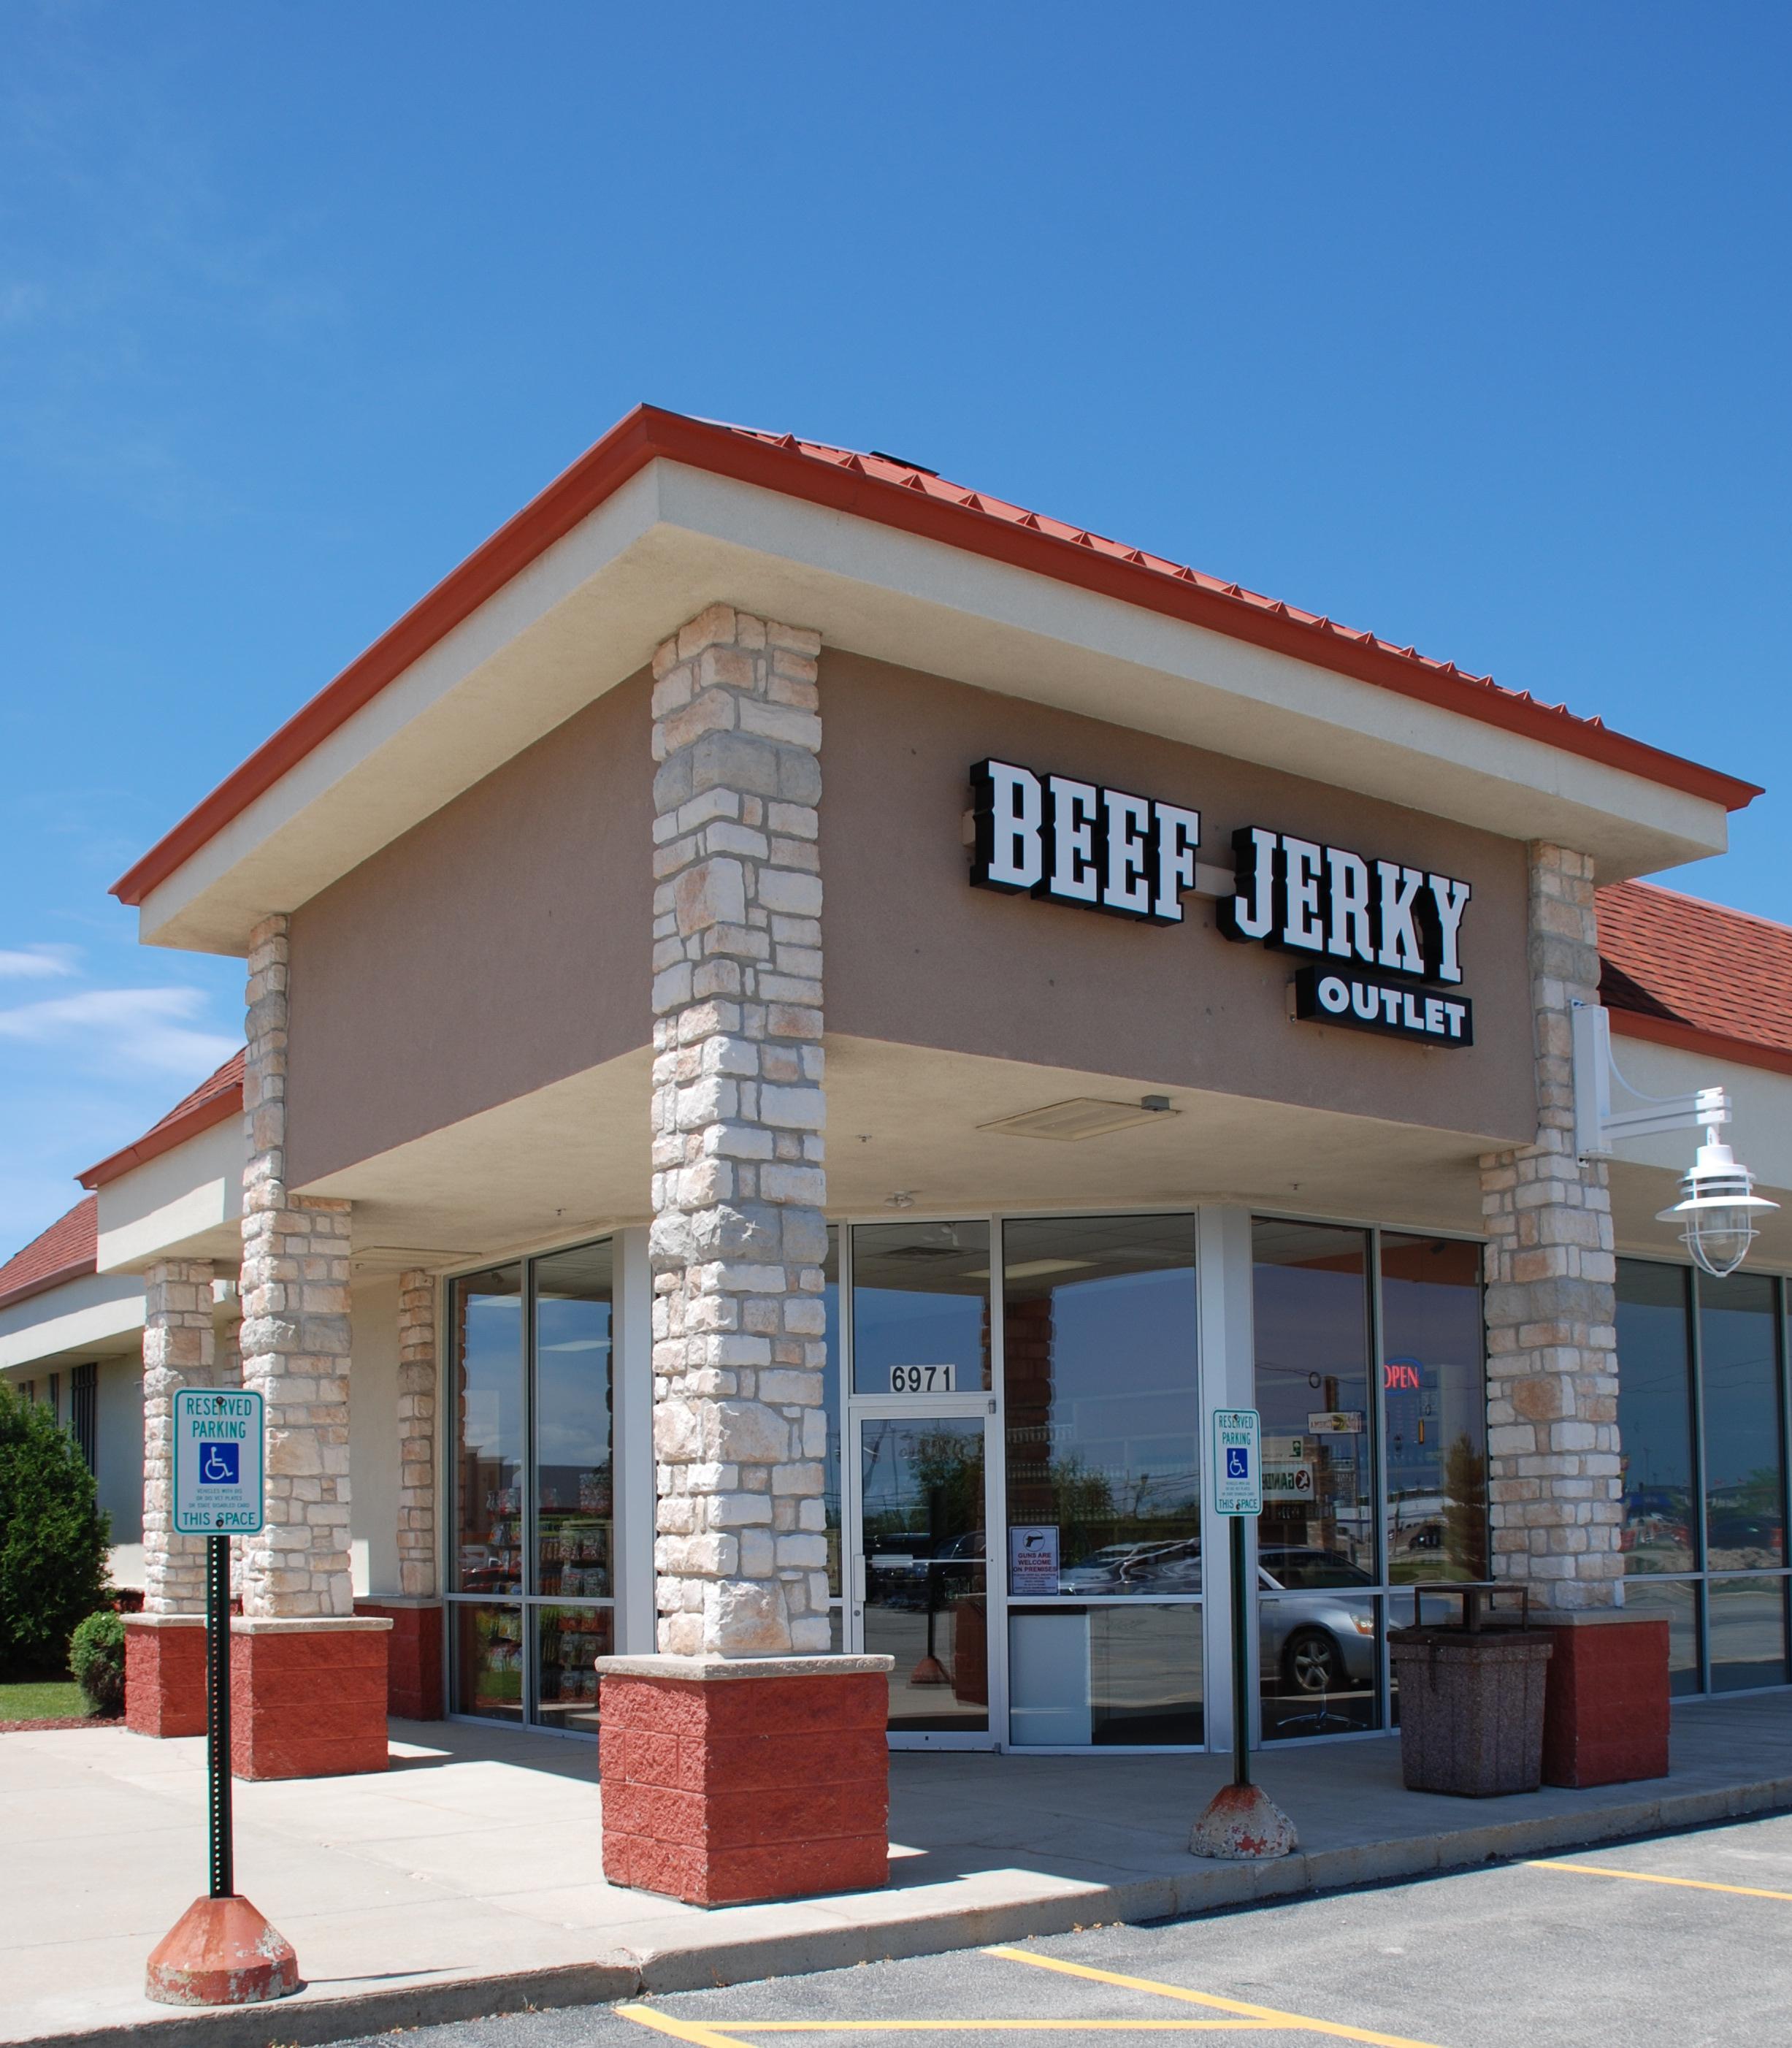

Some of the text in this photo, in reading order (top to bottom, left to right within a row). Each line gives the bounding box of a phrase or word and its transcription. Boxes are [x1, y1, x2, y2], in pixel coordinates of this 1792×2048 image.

[986, 757, 1472, 984] BEEF JERKY
[1317, 975, 1467, 1039] OUTLET
[892, 1366, 950, 1392] 6971
[186, 1397, 252, 1416] RESERVED
[192, 1420, 247, 1439] PARKING
[1219, 1415, 1254, 1429] RESERVED
[1222, 1432, 1251, 1445] PARKING
[1219, 1499, 1258, 1510] THIS SPACE
[183, 1512, 256, 1526] THIS SPACE
